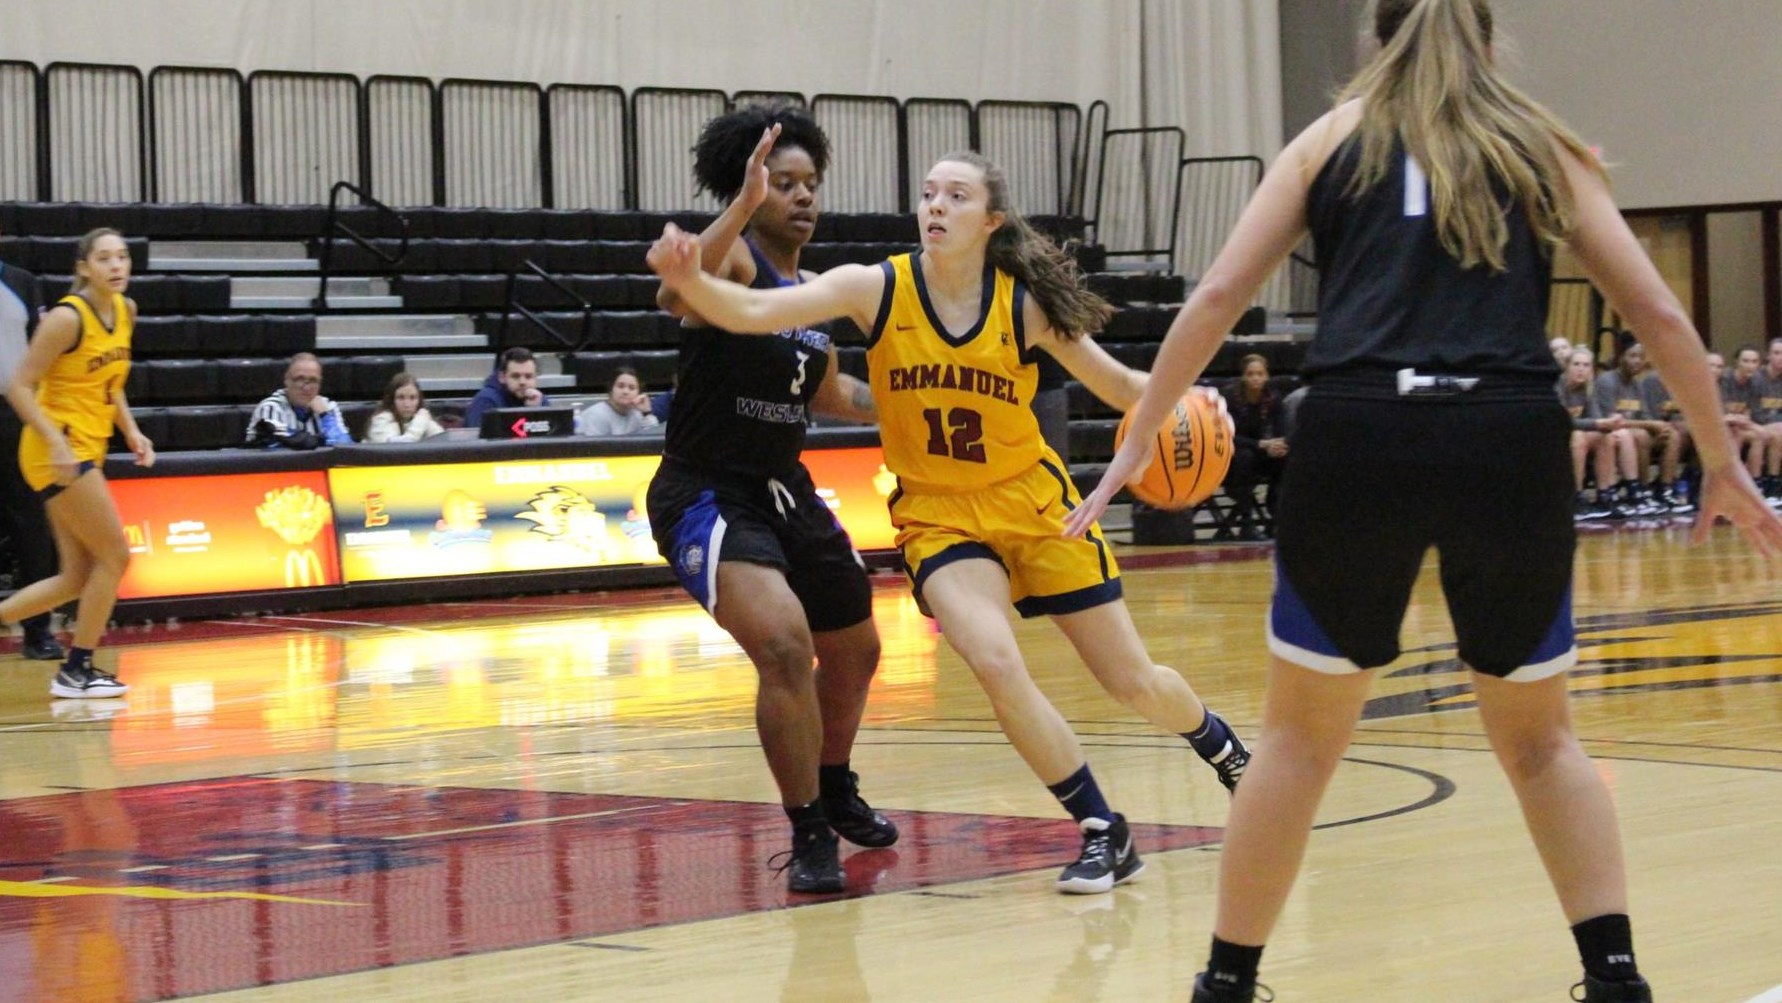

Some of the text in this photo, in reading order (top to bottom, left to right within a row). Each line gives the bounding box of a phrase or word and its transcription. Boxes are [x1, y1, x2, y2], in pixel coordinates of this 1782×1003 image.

[790, 350, 810, 395] 3
[889, 363, 1019, 406] EMMANUEL
[736, 396, 807, 424] WESL
[923, 406, 987, 464] 12
